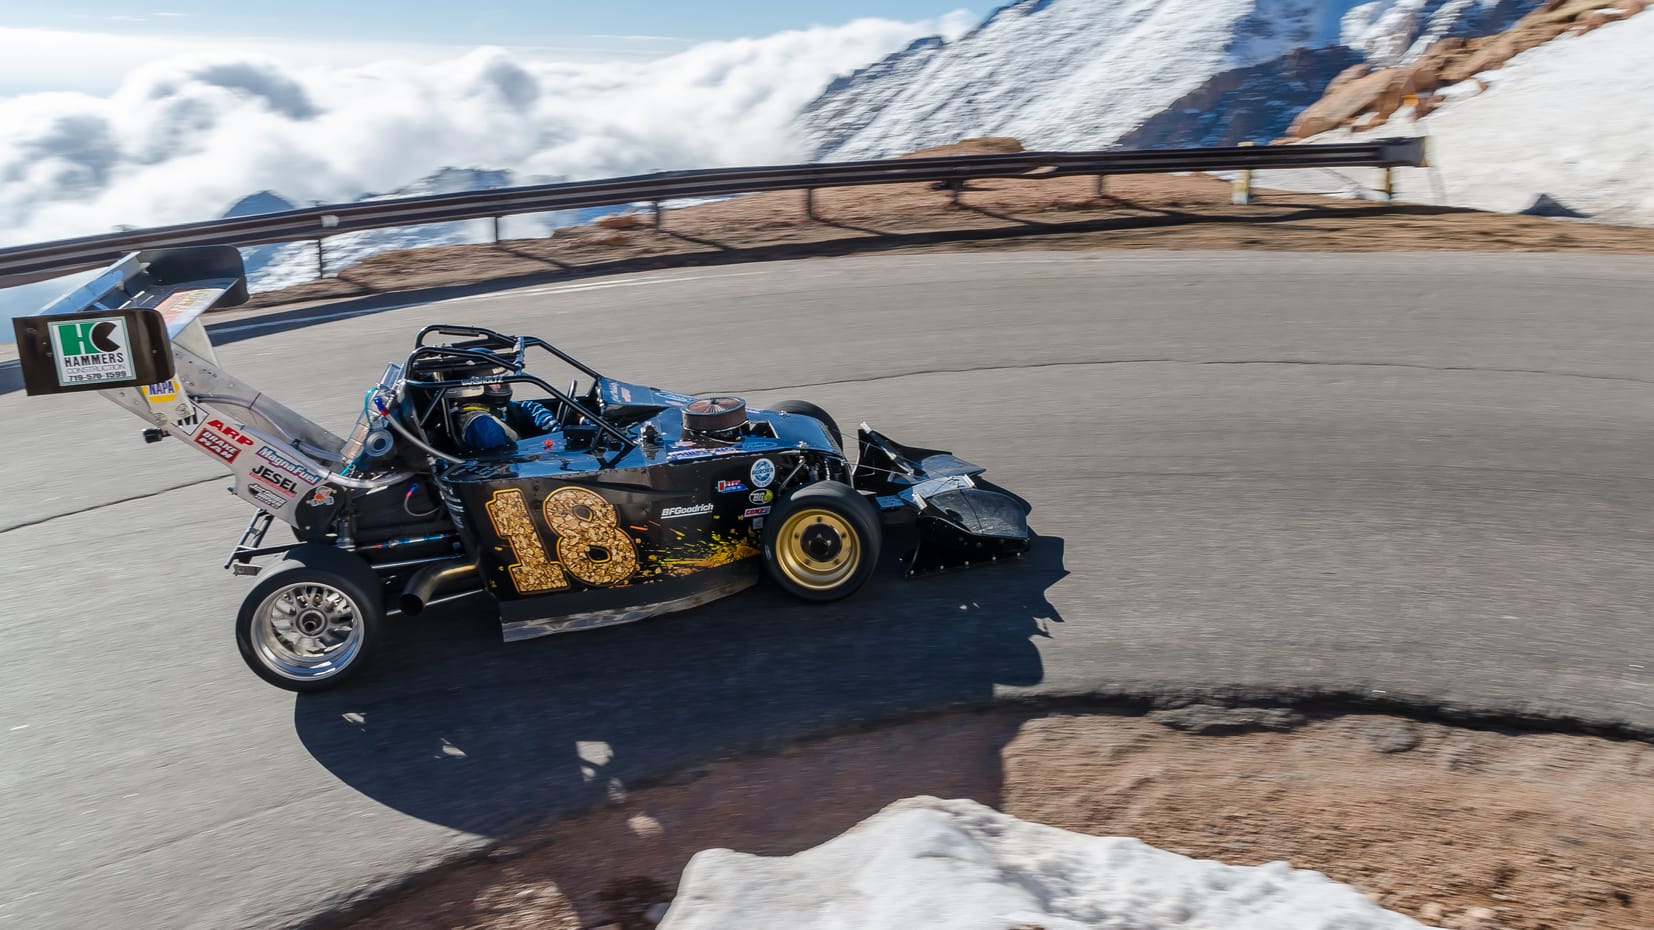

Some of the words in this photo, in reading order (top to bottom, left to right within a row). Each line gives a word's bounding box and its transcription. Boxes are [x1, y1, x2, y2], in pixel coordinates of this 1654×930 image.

[63, 352, 125, 368] HAMMERS
[147, 380, 174, 396] NAPA
[206, 419, 255, 446] ARP
[258, 445, 320, 485] MagnaFuel
[251, 465, 298, 495] JESEL
[660, 502, 715, 516] BFGoodrich
[484, 486, 640, 596] 18
